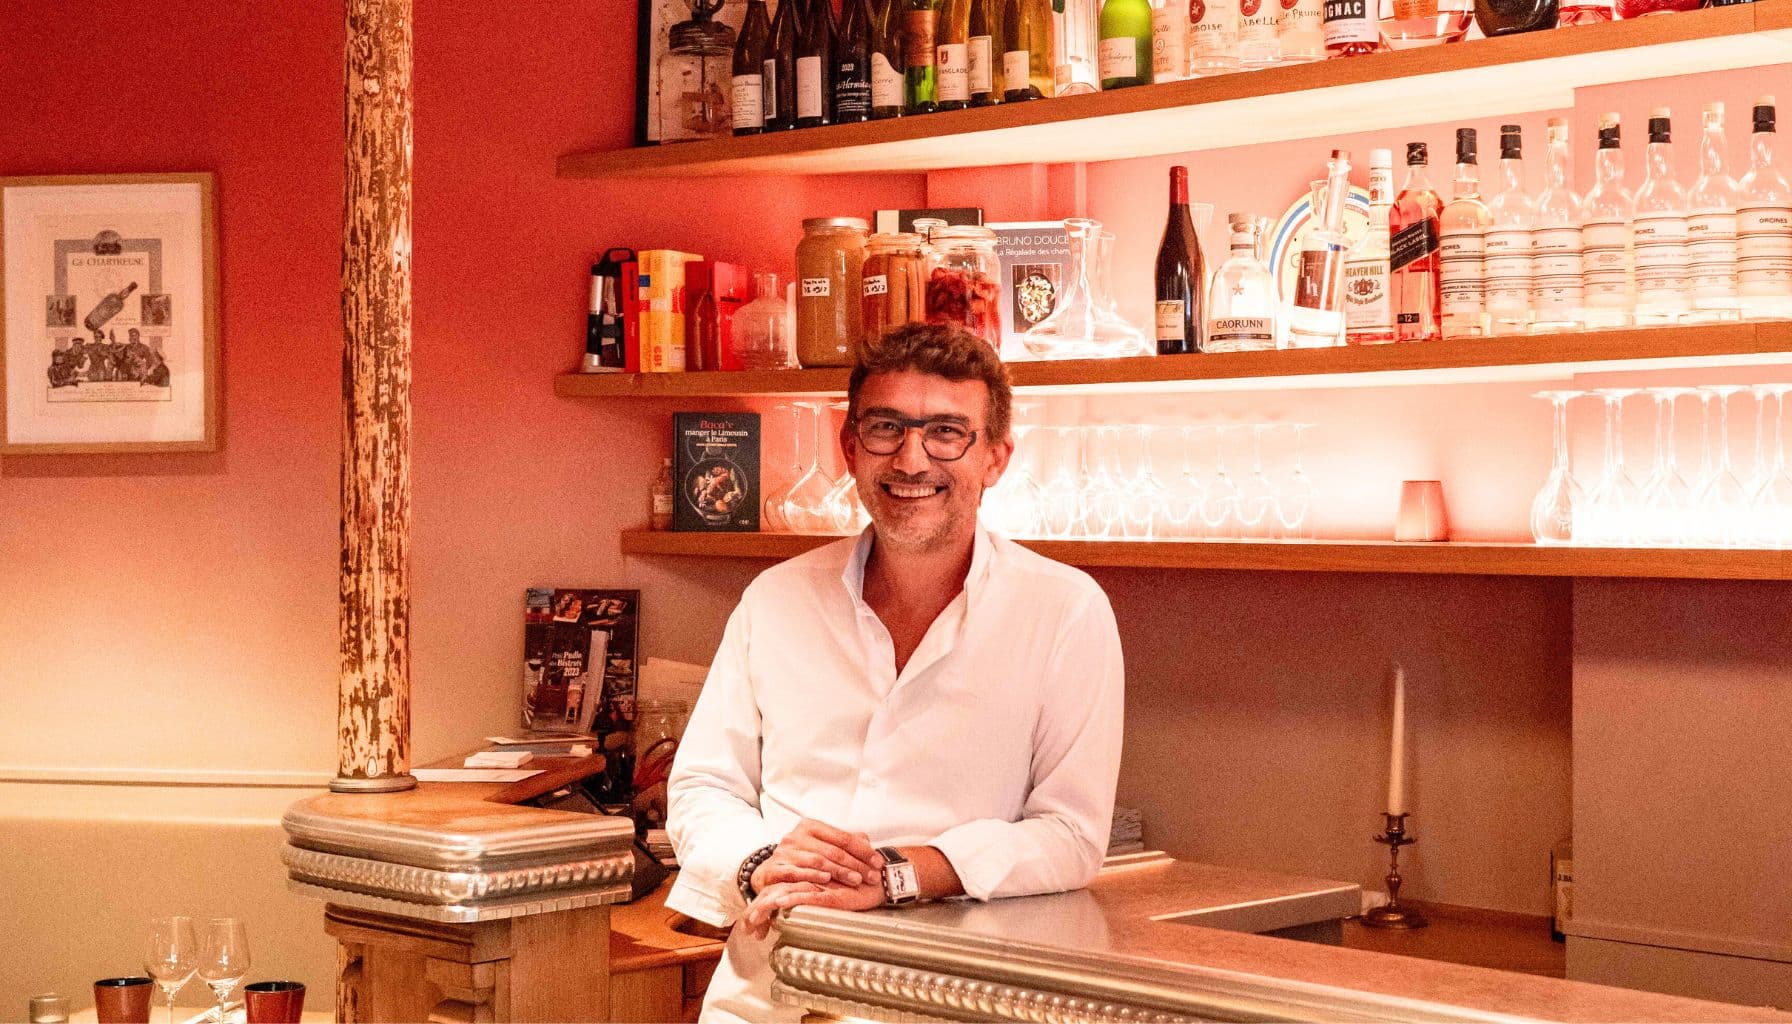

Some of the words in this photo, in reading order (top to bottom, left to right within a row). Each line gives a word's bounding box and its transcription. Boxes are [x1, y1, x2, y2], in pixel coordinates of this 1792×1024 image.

[1324, 2, 1361, 19] GNAC
[997, 235, 1032, 246] BRUNO
[1005, 248, 1036, 258] Régalade
[1037, 247, 1050, 255] des
[1404, 314, 1412, 322] 12
[1216, 319, 1264, 330] CAORUNN
[563, 667, 579, 676] 2023
